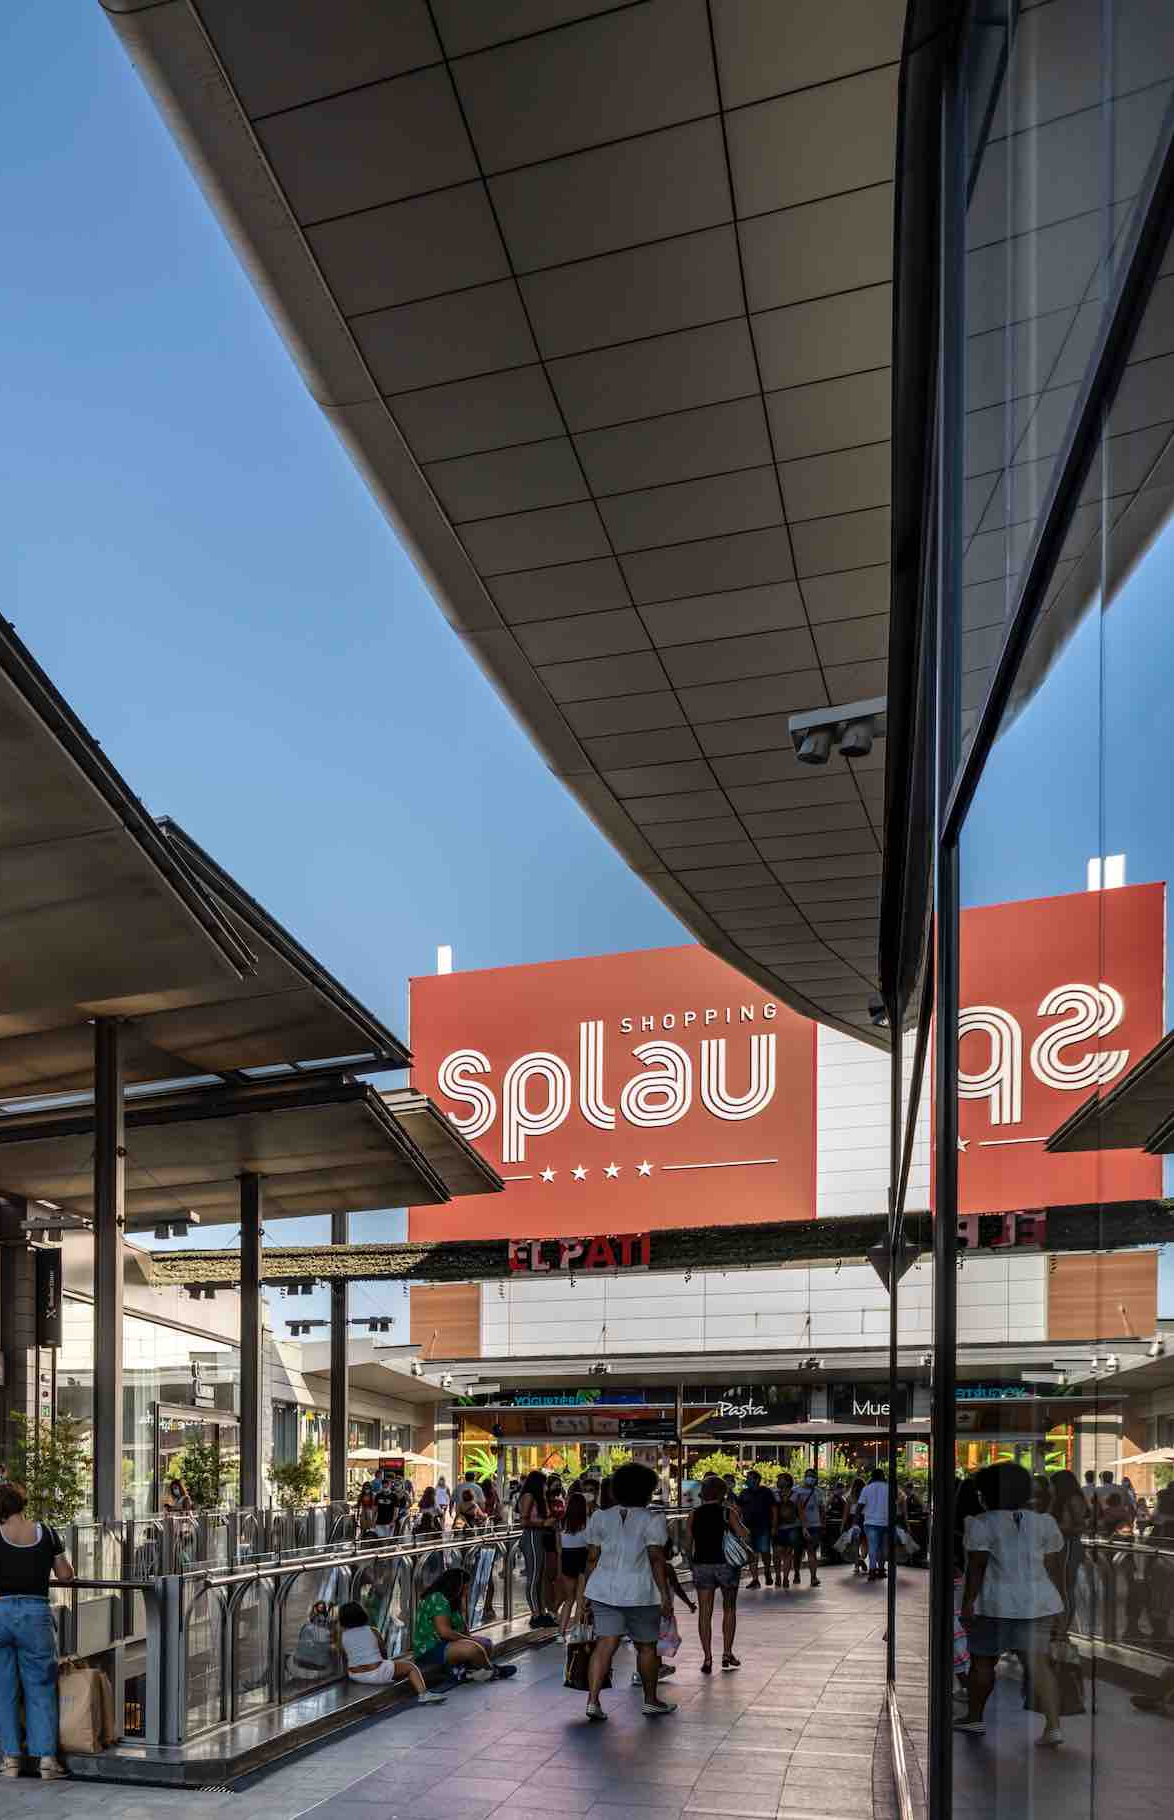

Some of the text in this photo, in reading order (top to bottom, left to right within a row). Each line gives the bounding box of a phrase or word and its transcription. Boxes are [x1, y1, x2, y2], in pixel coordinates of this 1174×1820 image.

[620, 1003, 778, 1033] SHOPPING
[437, 1020, 777, 1164] splau
[508, 1232, 651, 1272] EL PATI
[718, 1398, 768, 1419] Pasta
